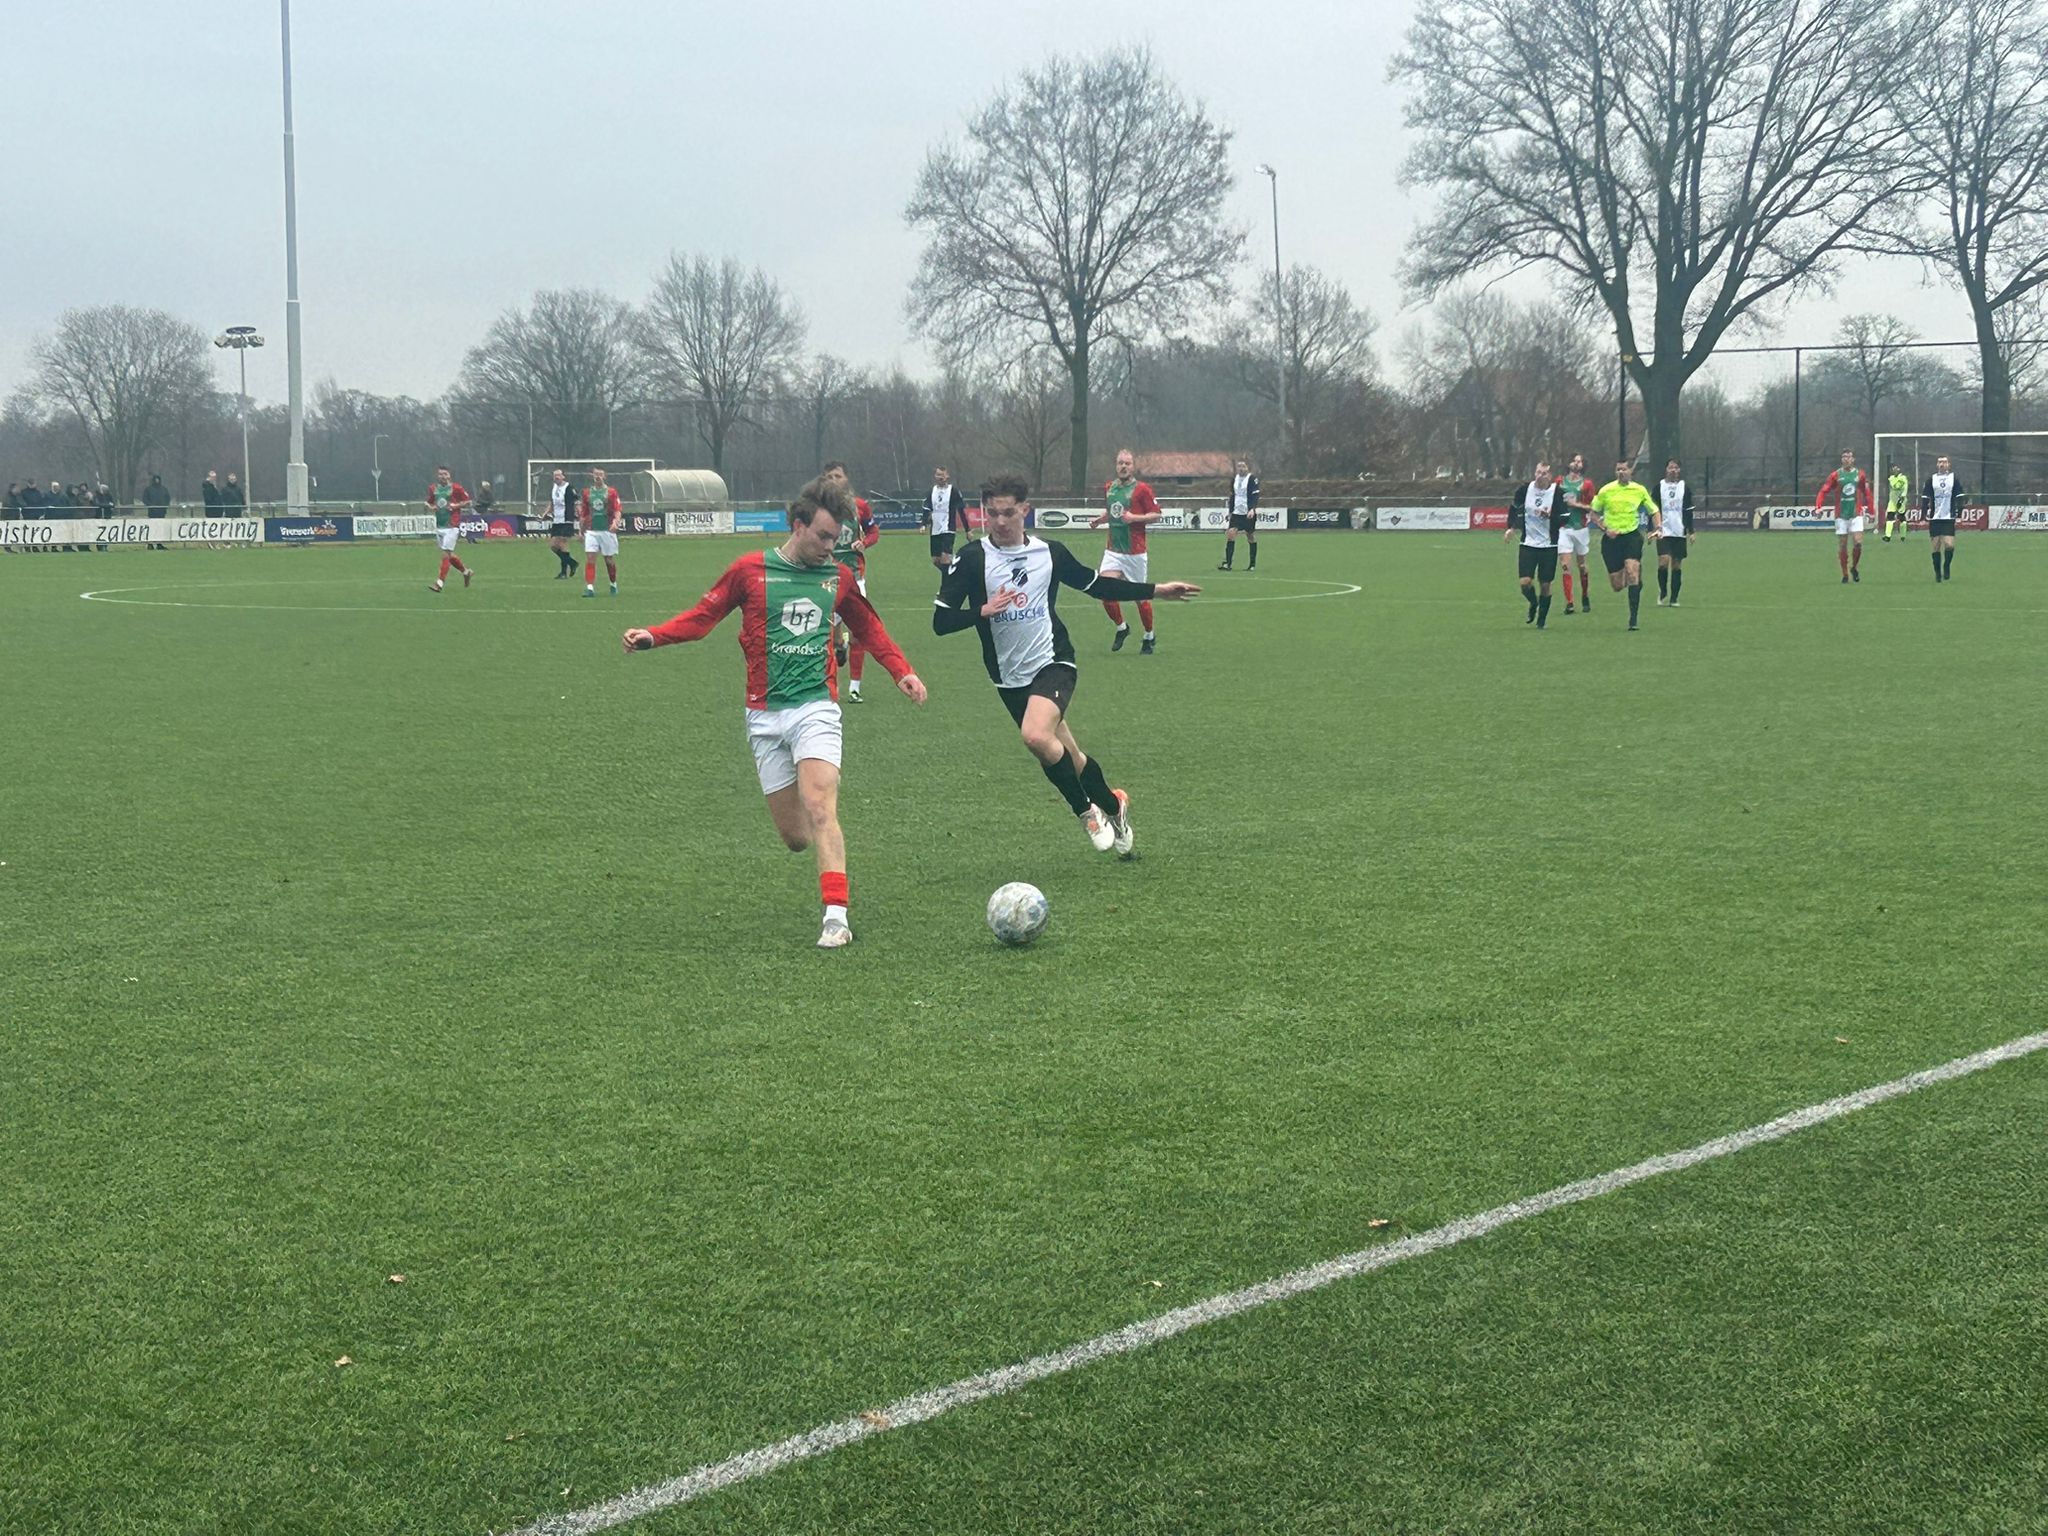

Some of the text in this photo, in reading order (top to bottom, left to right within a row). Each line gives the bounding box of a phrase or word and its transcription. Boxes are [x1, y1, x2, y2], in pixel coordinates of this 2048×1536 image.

[0, 521, 53, 544] istro
[96, 519, 150, 542] zalen
[178, 518, 258, 543] catering
